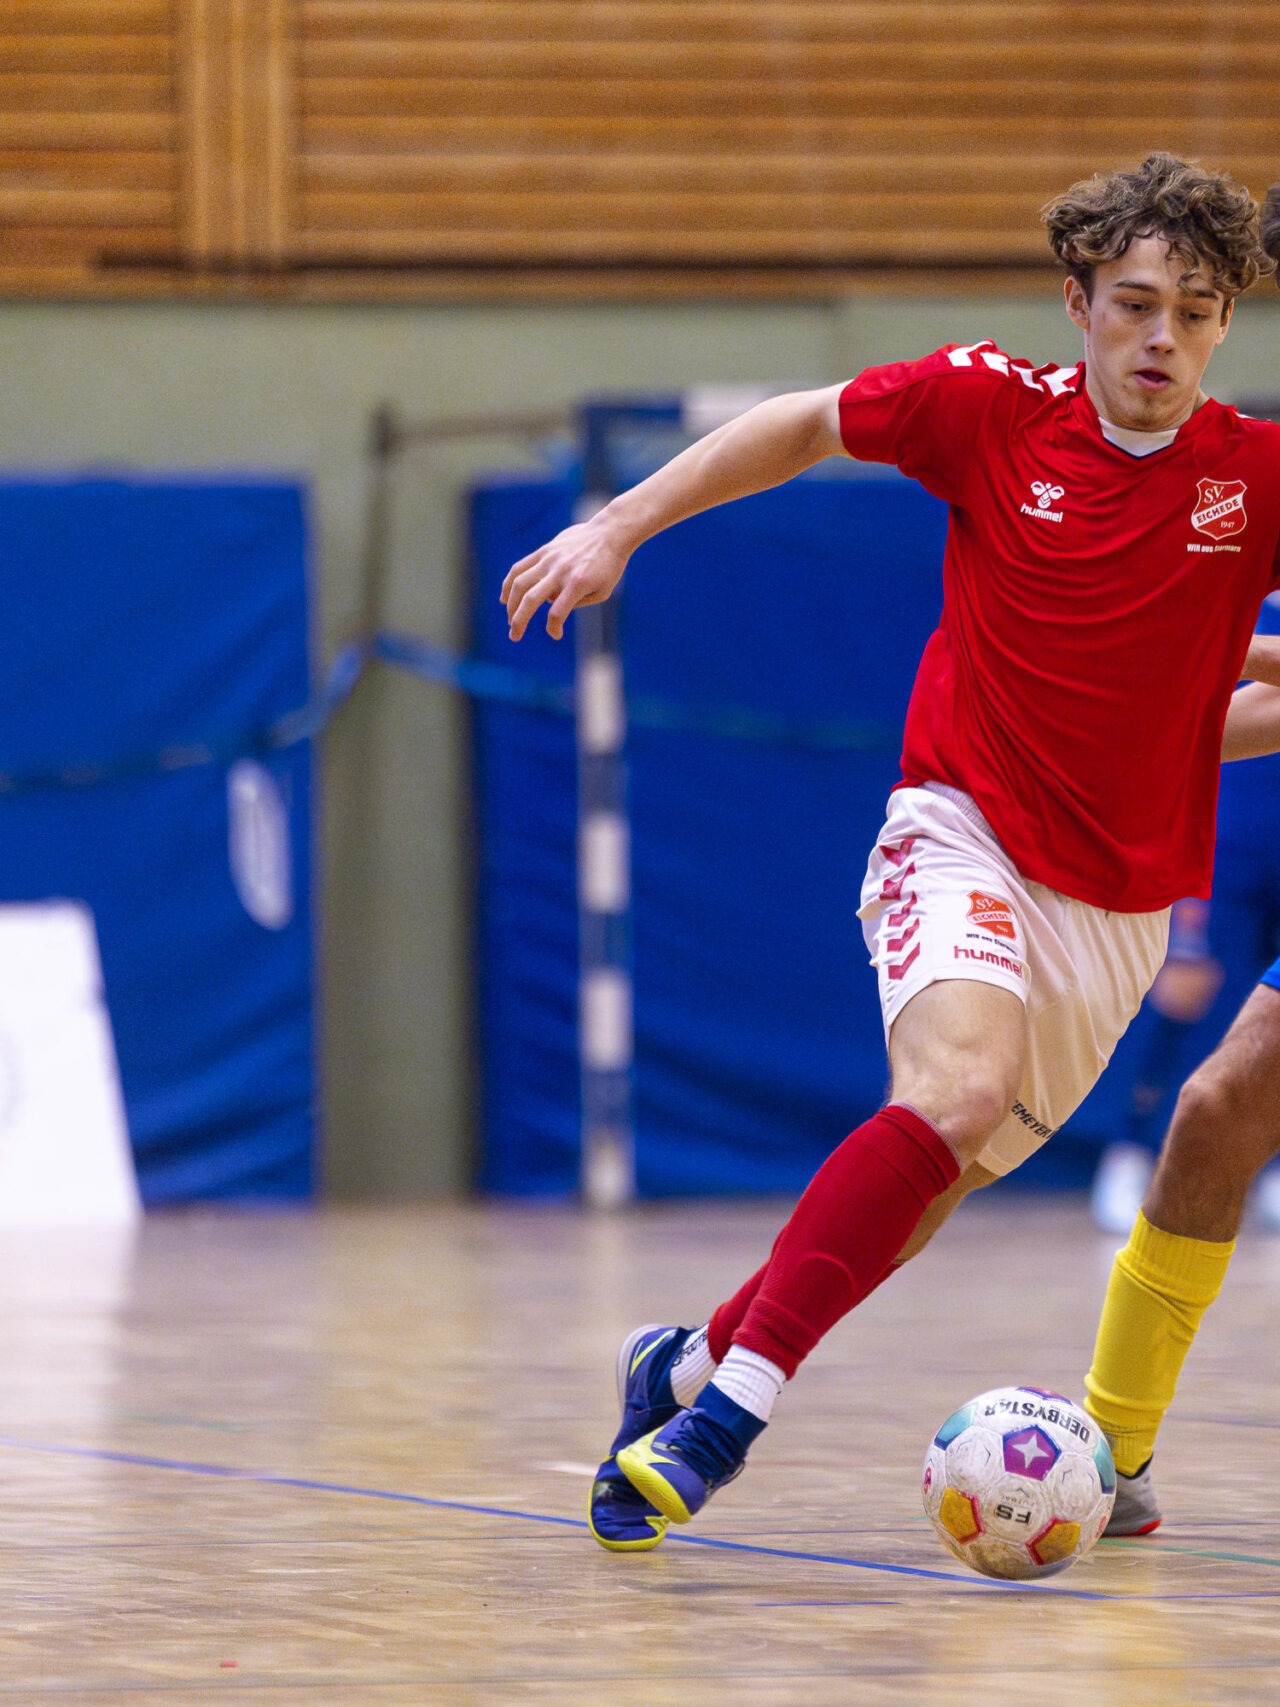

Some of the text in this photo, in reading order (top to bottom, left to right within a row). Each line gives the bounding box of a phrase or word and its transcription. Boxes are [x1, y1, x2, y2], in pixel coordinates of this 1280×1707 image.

[1020, 503, 1064, 523] hummel
[1196, 498, 1240, 524] EICHEDE
[1010, 1099, 1059, 1140] EMEYER
[984, 1398, 1091, 1444] DERBYSTAR
[995, 1504, 1032, 1525] FS
